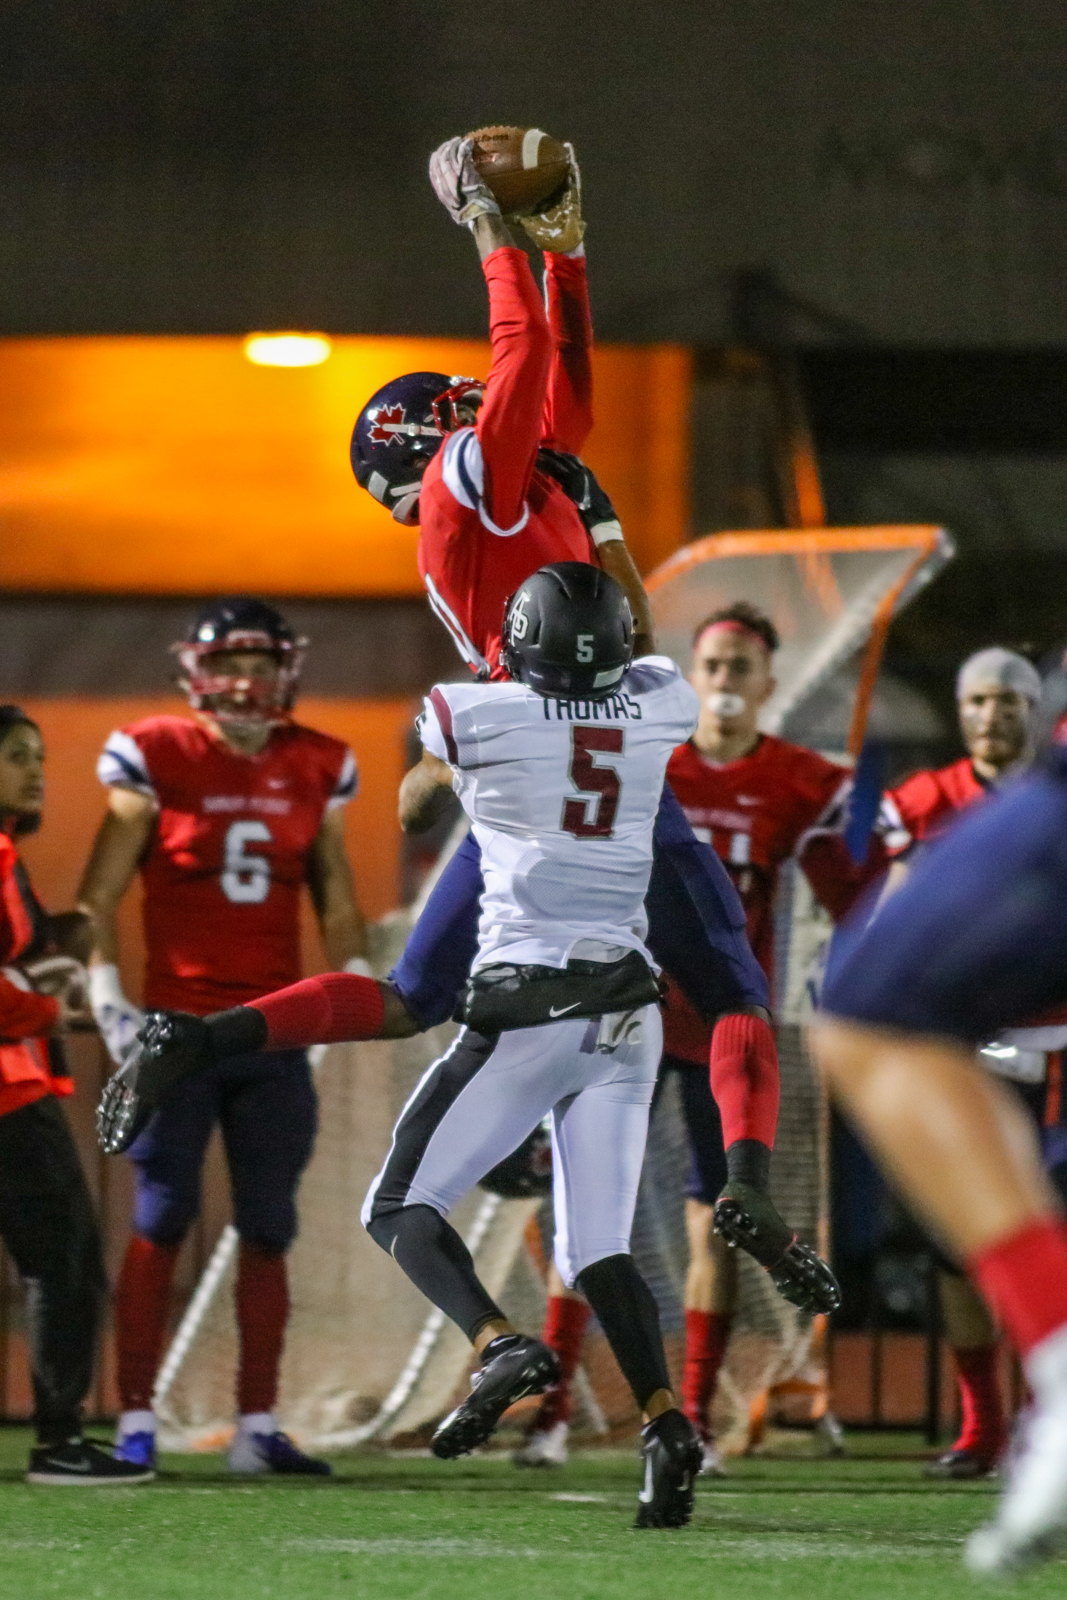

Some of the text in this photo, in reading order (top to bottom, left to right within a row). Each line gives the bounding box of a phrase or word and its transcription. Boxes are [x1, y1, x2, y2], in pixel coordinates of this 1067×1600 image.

[577, 634, 594, 663] 5
[543, 694, 642, 720] THOMAS
[559, 722, 626, 841] 5
[222, 821, 271, 903] 6
